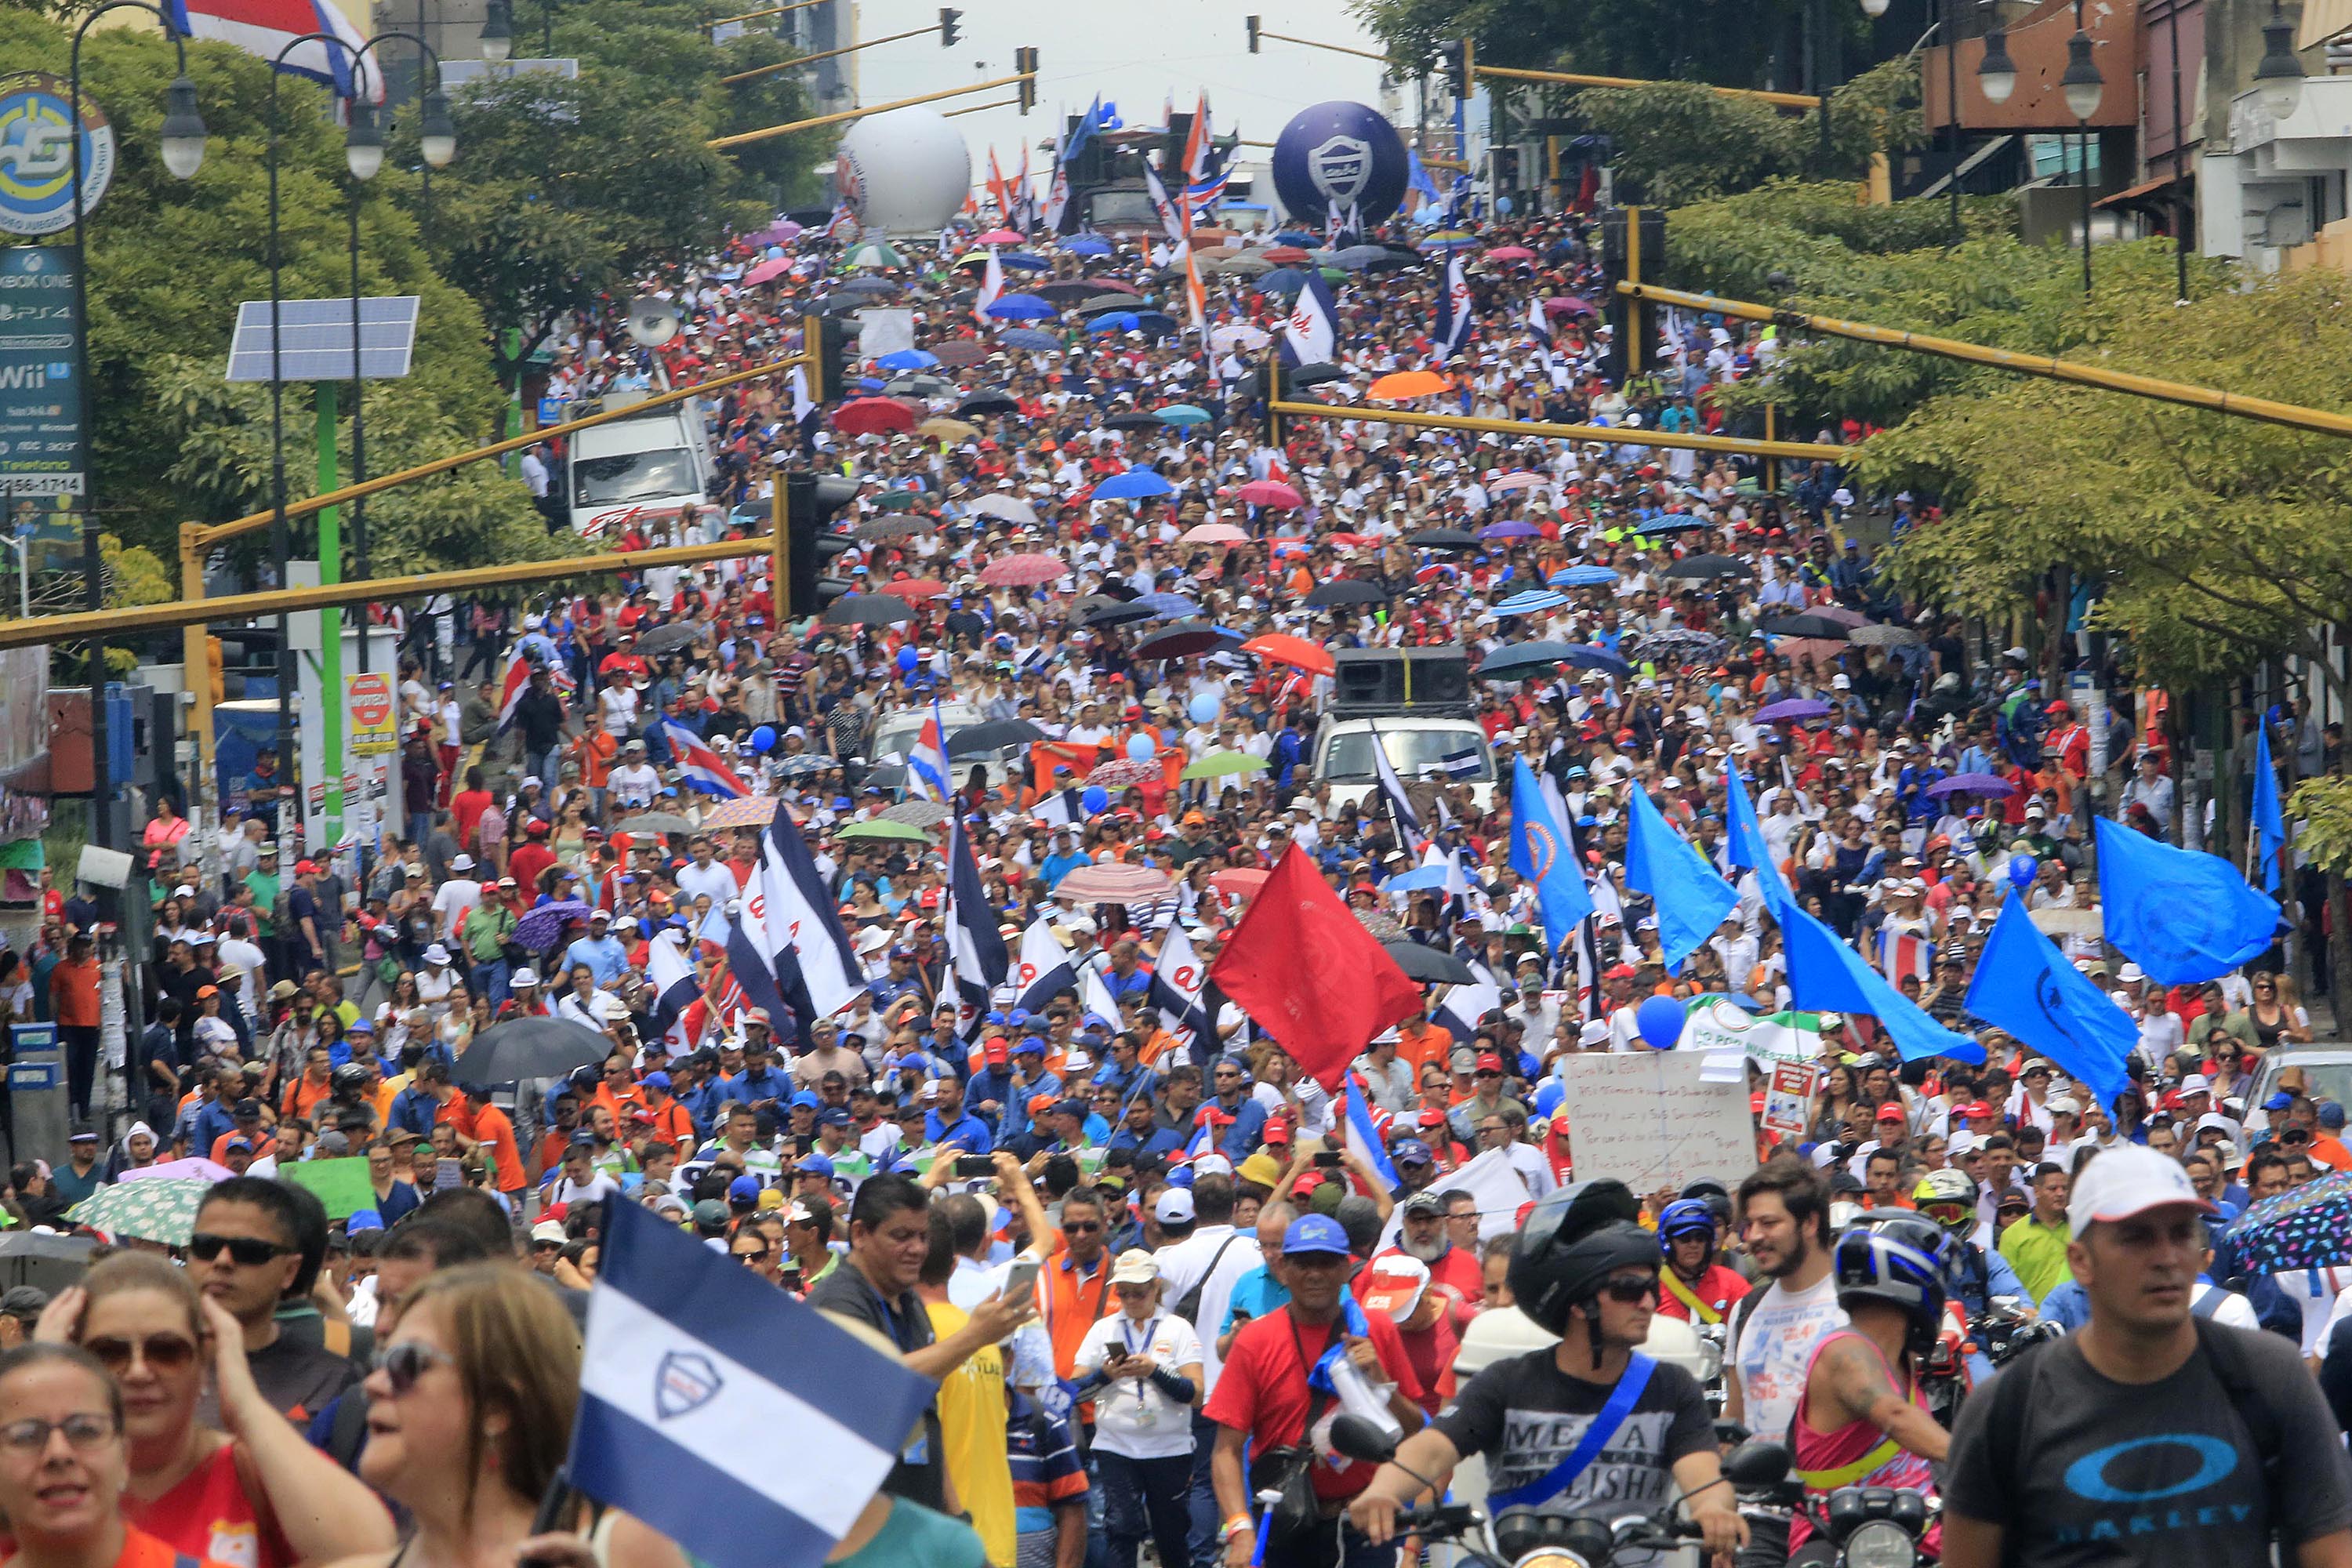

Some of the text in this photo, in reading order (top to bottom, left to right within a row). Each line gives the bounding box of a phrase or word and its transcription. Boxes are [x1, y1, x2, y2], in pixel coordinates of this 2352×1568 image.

[41, 274, 74, 289] ONE
[16, 306, 72, 320] PS4
[0, 364, 45, 389] Wii
[1506, 1420, 1646, 1451] MEA
